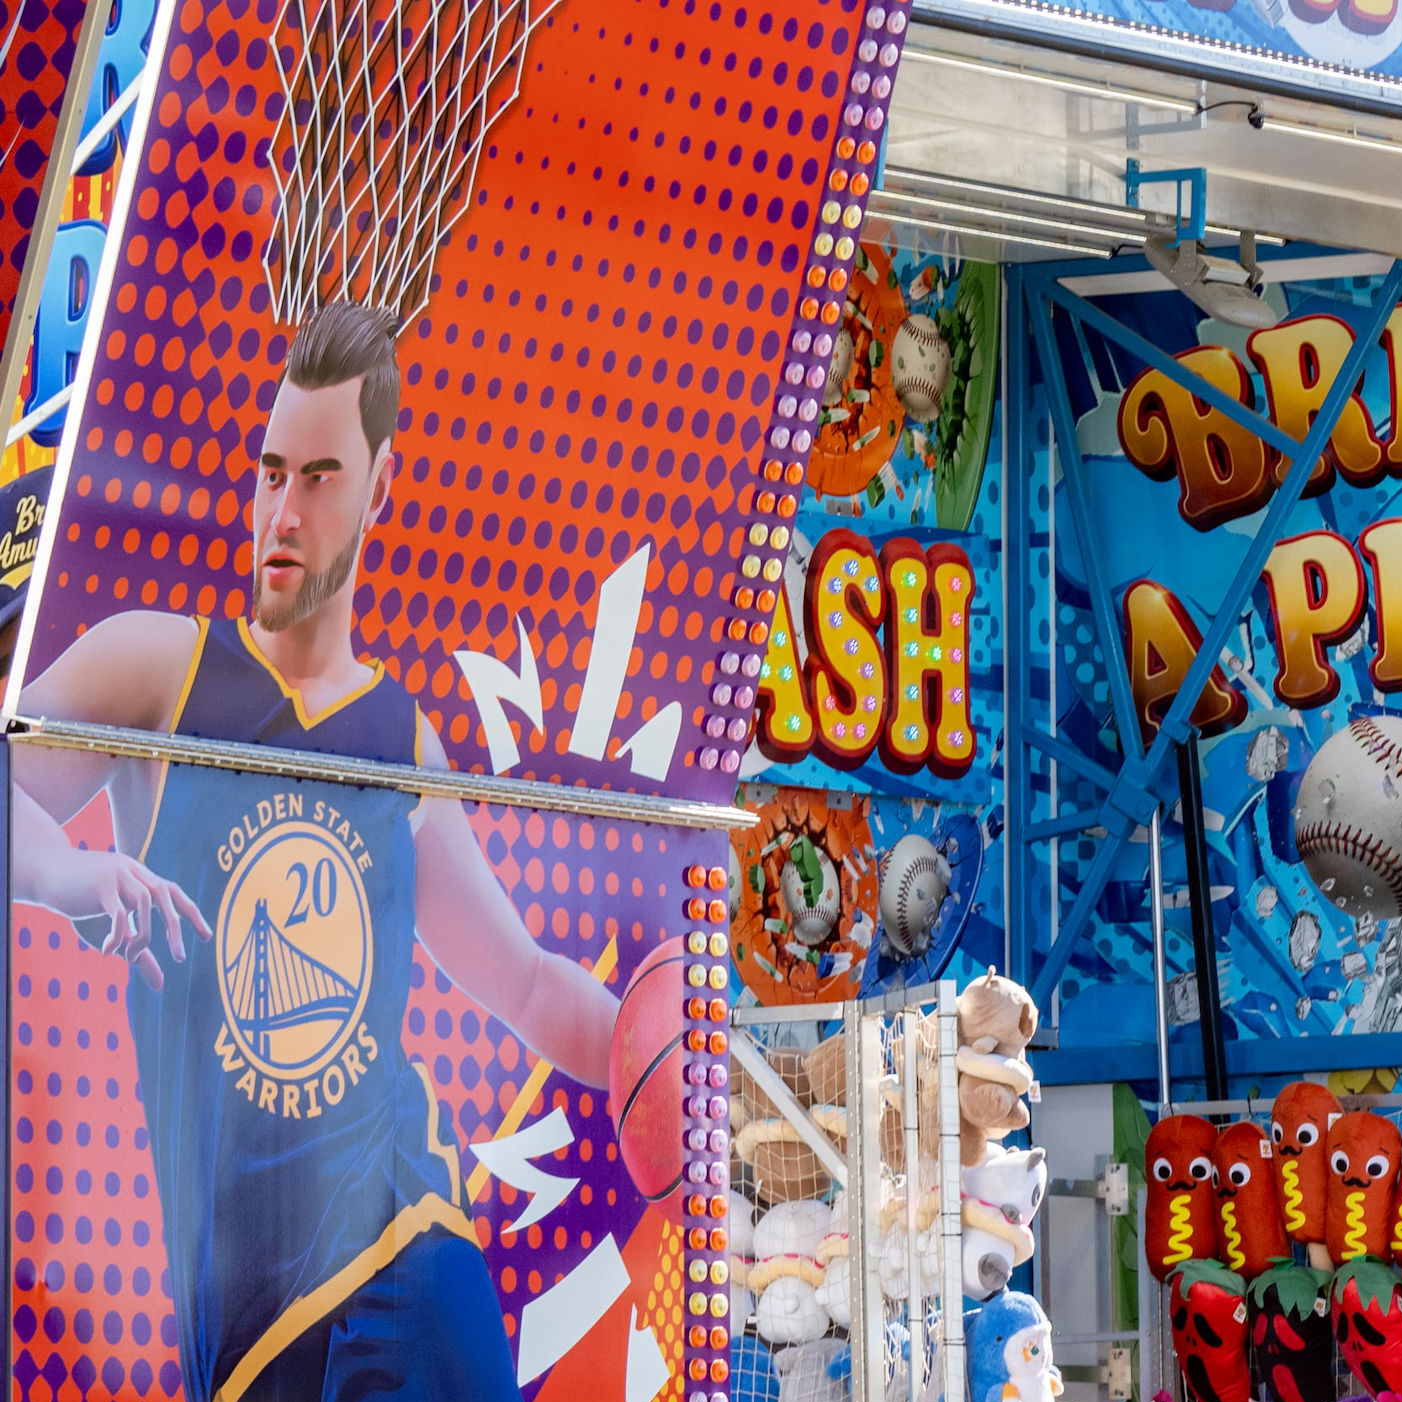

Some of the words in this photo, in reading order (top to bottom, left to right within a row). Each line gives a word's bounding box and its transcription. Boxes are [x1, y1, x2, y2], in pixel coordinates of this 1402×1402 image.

[1122, 578, 1248, 748] A
[217, 793, 304, 872] GOLDEN
[313, 800, 373, 873] STATE
[284, 857, 337, 929] 20
[214, 1021, 378, 1120] WARRIORS
